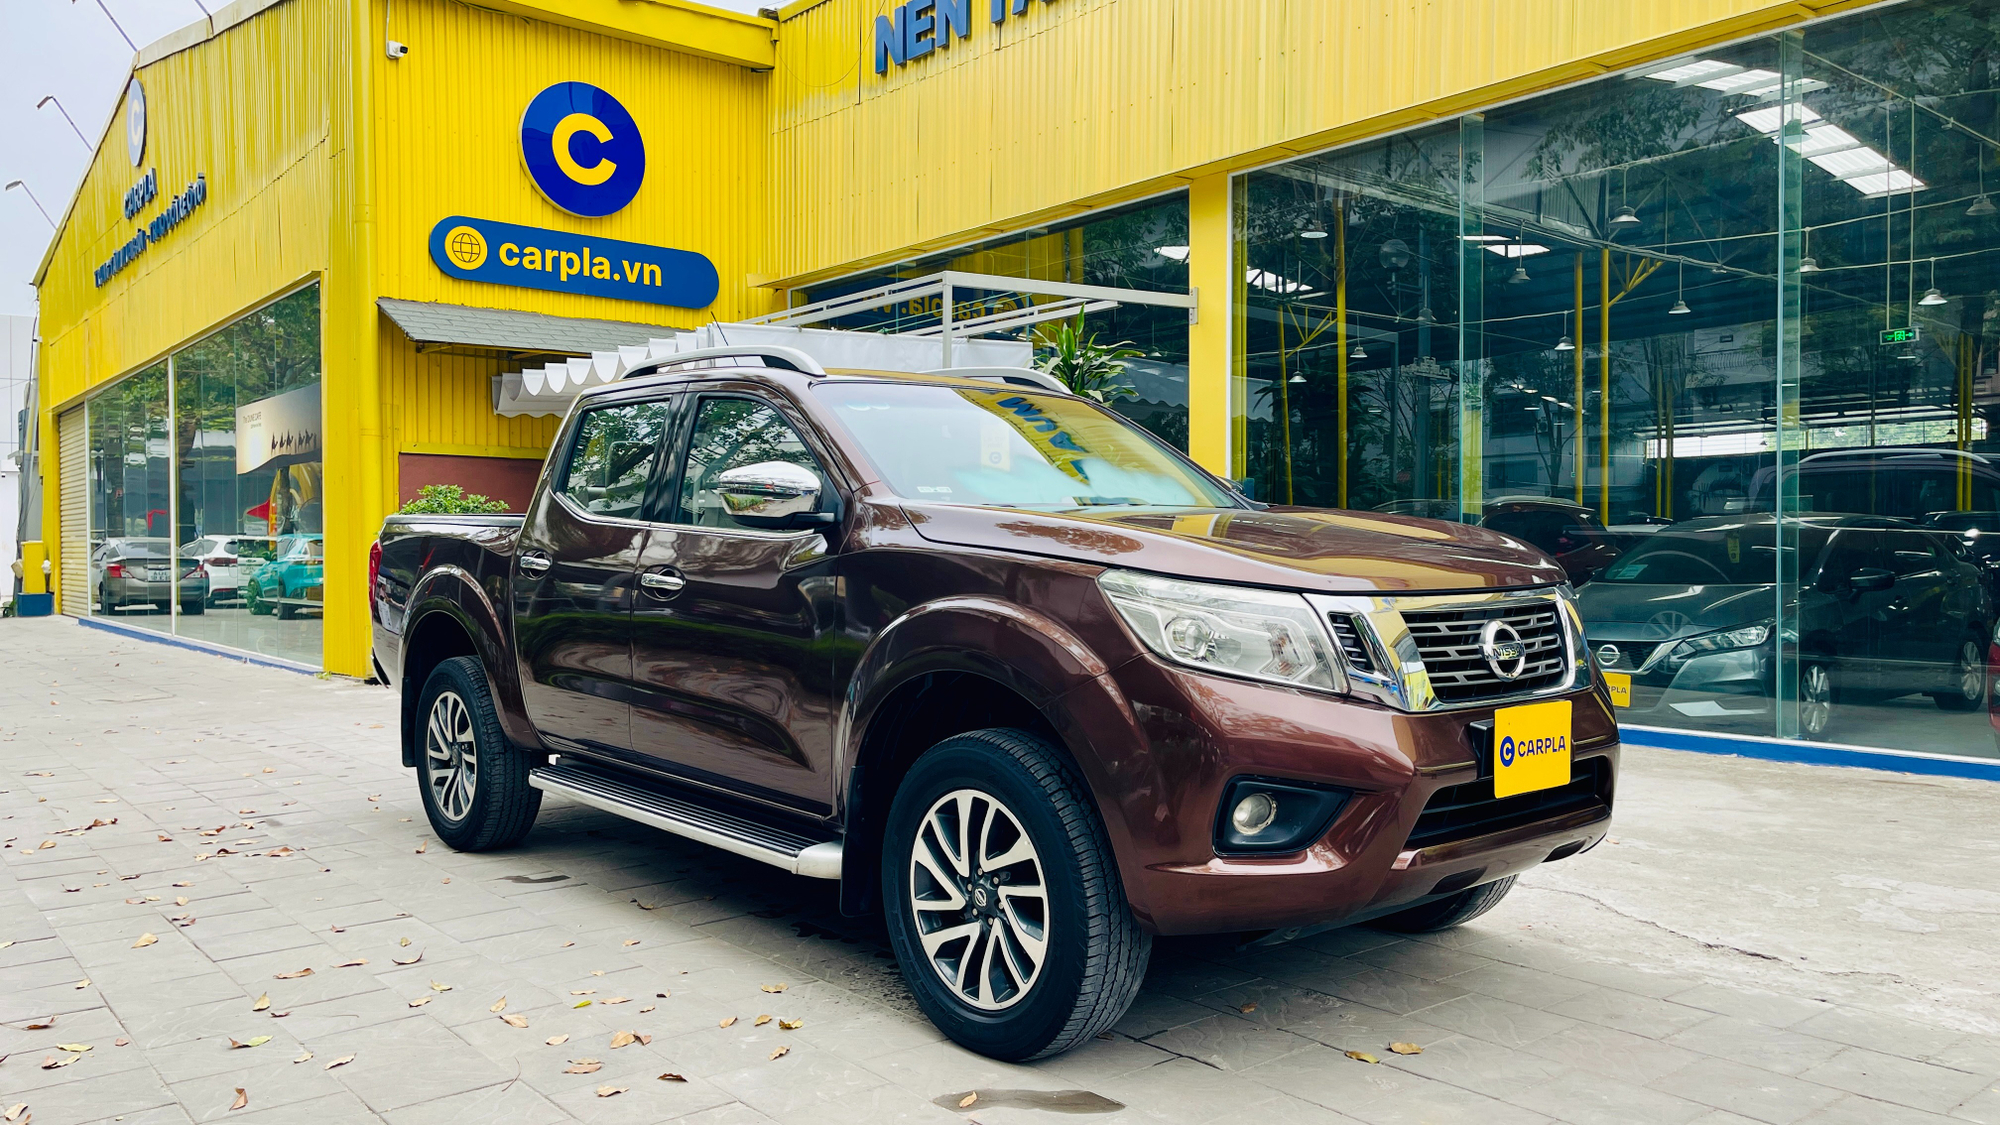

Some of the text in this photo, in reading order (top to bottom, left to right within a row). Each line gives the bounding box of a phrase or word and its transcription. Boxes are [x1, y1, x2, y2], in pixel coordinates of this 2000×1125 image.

[552, 113, 617, 186] C
[124, 167, 158, 220] CARPLA
[499, 242, 662, 287] carpla.vn
[1517, 735, 1566, 757] CARPLA
